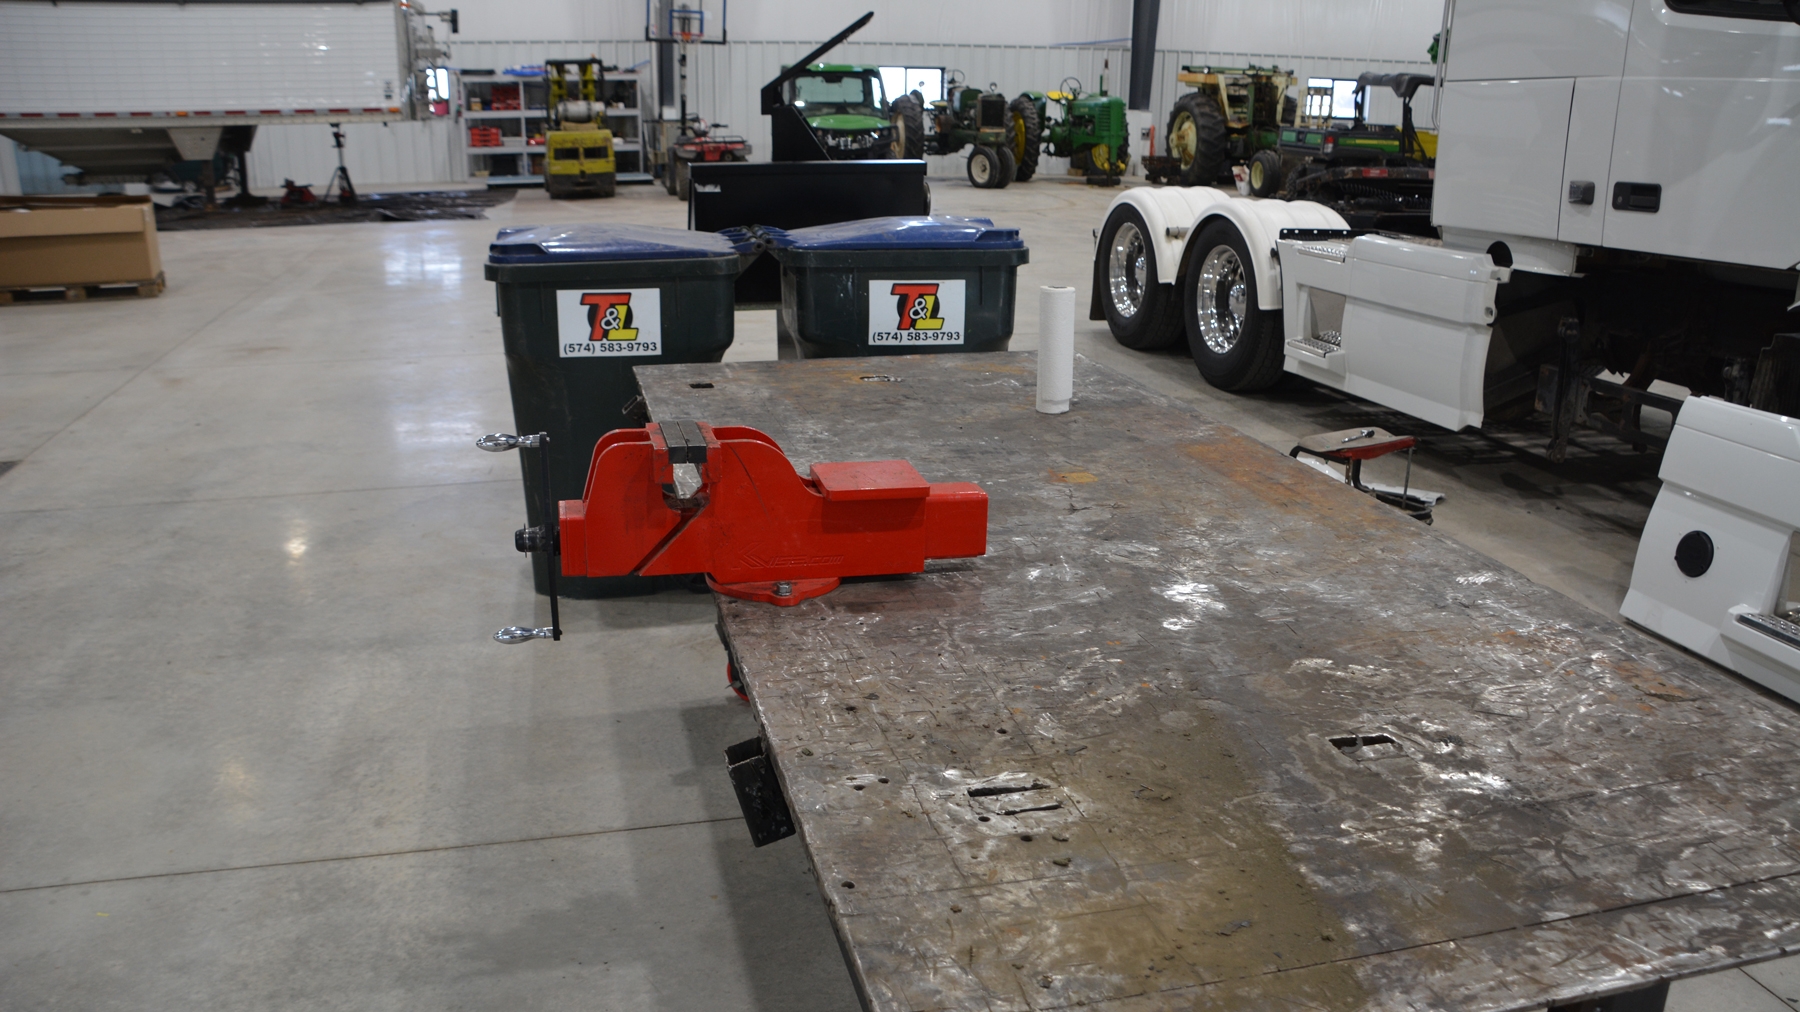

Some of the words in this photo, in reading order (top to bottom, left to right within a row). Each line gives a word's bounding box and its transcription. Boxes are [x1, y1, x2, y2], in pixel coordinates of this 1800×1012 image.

[580, 292, 639, 341] T&L
[890, 283, 945, 330] T&L
[563, 343, 596, 355] (574)
[600, 341, 658, 353] 583-9793
[872, 331, 903, 343] (574)
[907, 331, 960, 341] 583-9793
